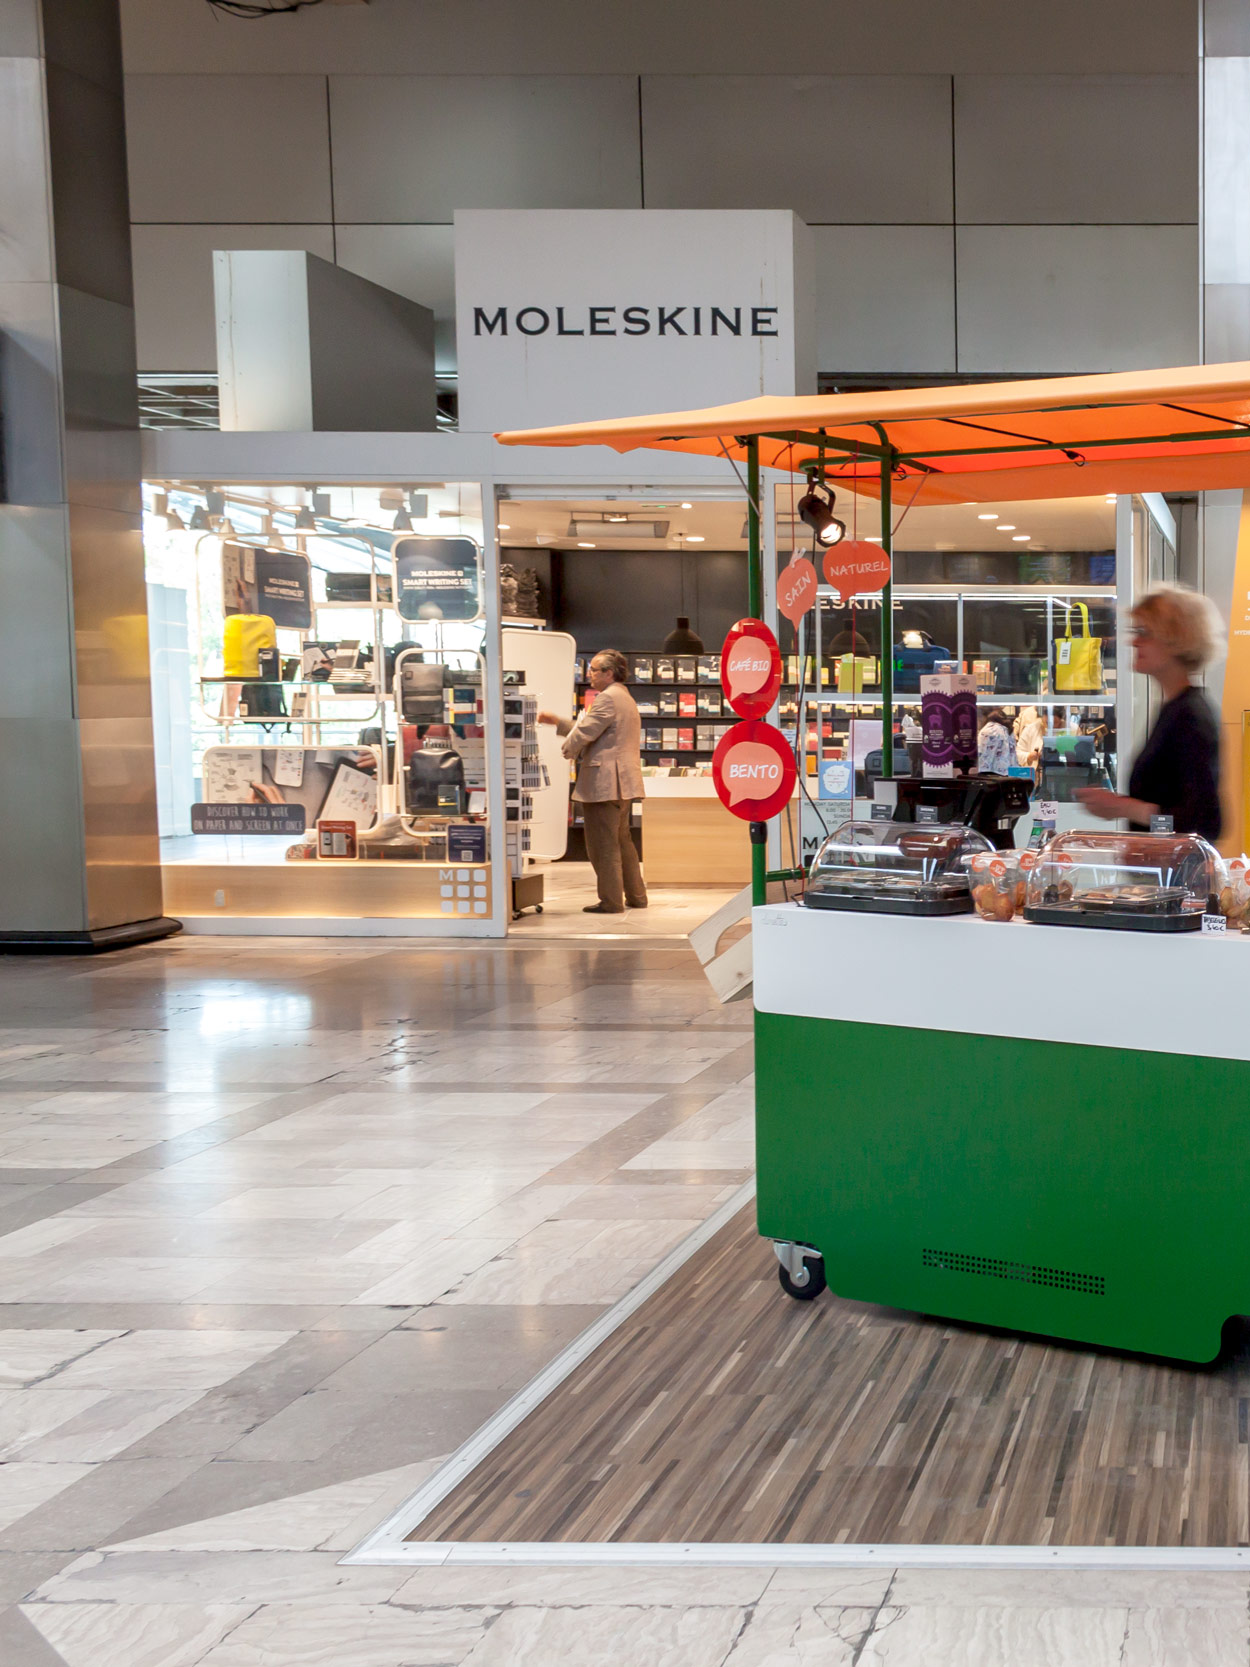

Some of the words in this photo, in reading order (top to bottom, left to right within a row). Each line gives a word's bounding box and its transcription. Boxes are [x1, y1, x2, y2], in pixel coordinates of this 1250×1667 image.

[473, 306, 778, 337] MOLESKINE
[830, 561, 889, 577] NATUREL
[785, 570, 812, 607] SAIN
[729, 657, 752, 672] CAFÉ
[751, 660, 770, 672] BIO
[729, 763, 779, 779] BENTO
[207, 806, 239, 817] DISCOVER
[241, 806, 256, 817] HOW
[258, 806, 268, 817] TO
[270, 806, 289, 817] WORK
[193, 820, 204, 831] ON
[205, 820, 226, 831] PAPER
[229, 820, 244, 831] AND
[246, 820, 271, 831] SCREEN
[272, 820, 283, 831] AT
